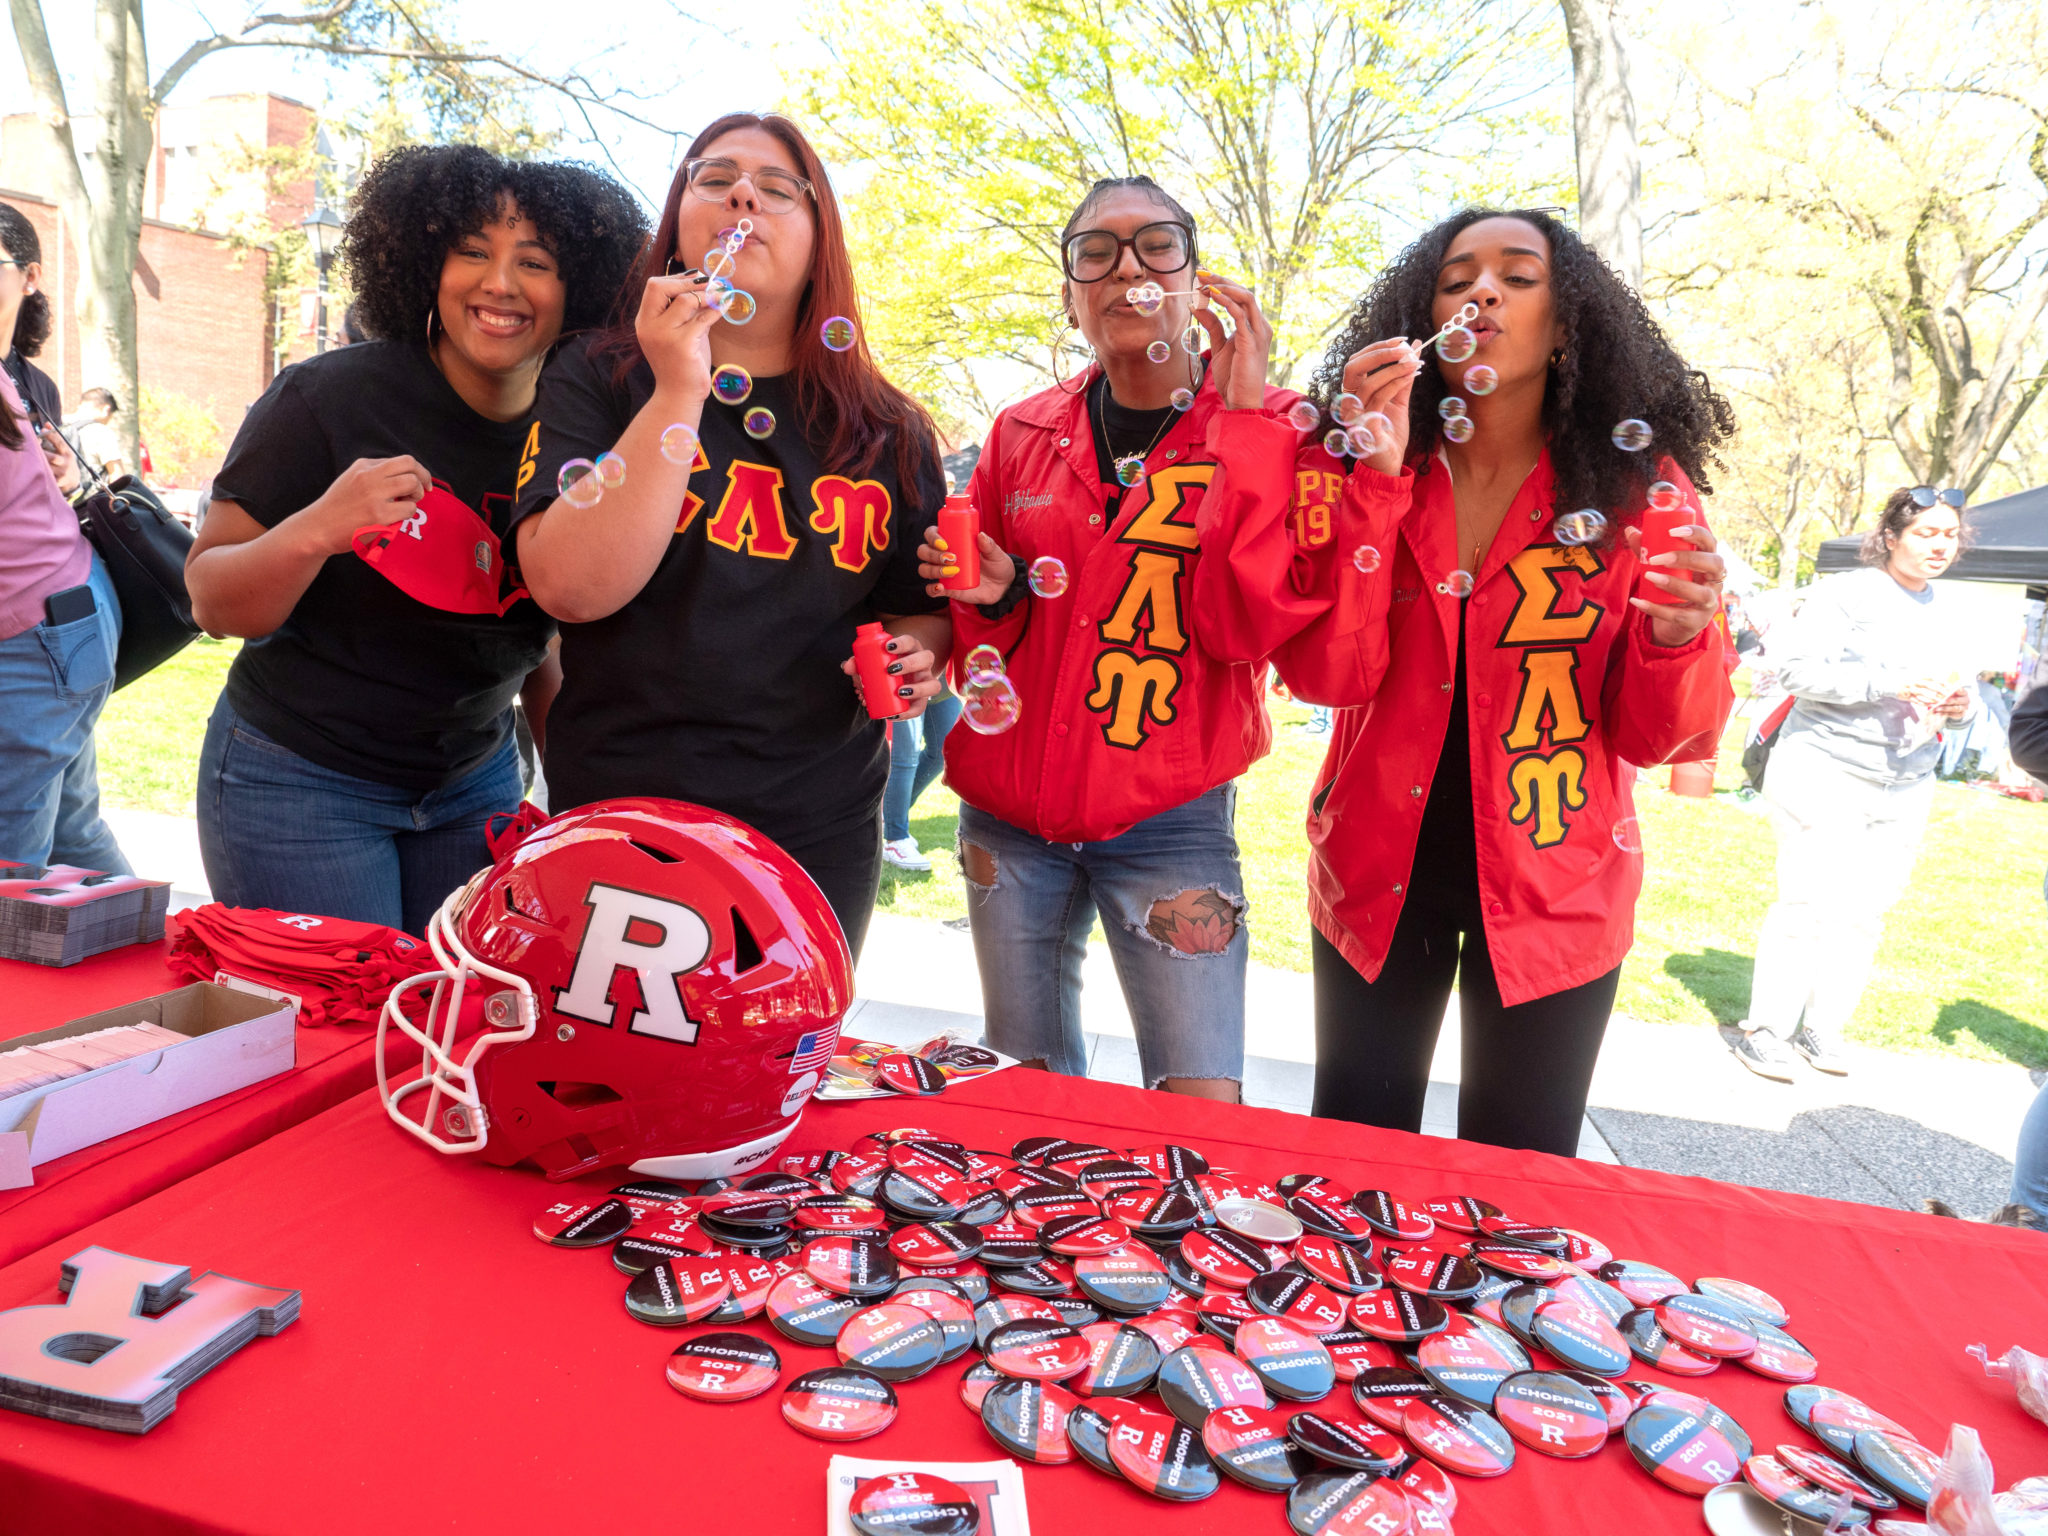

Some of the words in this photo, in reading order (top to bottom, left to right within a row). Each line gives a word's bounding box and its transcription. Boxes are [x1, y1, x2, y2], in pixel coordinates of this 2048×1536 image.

[400, 507, 428, 541] R
[1294, 503, 1332, 547] 19
[276, 914, 324, 931] R
[552, 880, 712, 1046] R
[912, 1152, 940, 1166] 2021
[913, 1144, 963, 1170] CHOPPED
[1056, 1148, 1109, 1160] CHOPPED
[1075, 1157, 1103, 1166] 2021
[916, 1174, 944, 1191] 2021
[934, 1171, 956, 1184] R
[1092, 1171, 1150, 1179] CHOPPED
[891, 1172, 938, 1206] CHOPPED
[1026, 1194, 1085, 1204] CHOPPED
[1043, 1204, 1077, 1212] 2021
[546, 1202, 573, 1215] R
[563, 1205, 591, 1223] 2021
[566, 1204, 614, 1238] CHOPPED
[669, 1219, 693, 1233] R
[1053, 1216, 1101, 1238] CHOPPED
[651, 1232, 684, 1243] 2021
[918, 1232, 940, 1247] 2021
[930, 1223, 967, 1250] CHOPPED
[1076, 1225, 1104, 1238] 2021
[1093, 1232, 1119, 1245] R
[622, 1240, 684, 1258] CHOPPED
[897, 1239, 921, 1252] R
[1210, 1233, 1265, 1272] CHOPPED
[809, 1249, 829, 1263] R
[838, 1249, 847, 1270] 2021
[1198, 1253, 1222, 1271] R
[1208, 1245, 1239, 1266] 2021
[1396, 1259, 1418, 1270] R
[748, 1265, 772, 1283] R
[858, 1246, 868, 1286] CHOPPED
[1420, 1260, 1435, 1277] 2021
[1437, 1259, 1457, 1290] CHOPPED
[679, 1271, 695, 1296] 2021
[700, 1268, 723, 1286] R
[729, 1268, 747, 1292] 2021
[789, 1274, 817, 1289] R
[1089, 1276, 1156, 1284] CHOPPED
[654, 1266, 675, 1309] CHOPPED
[796, 1289, 832, 1304] 2021
[1273, 1276, 1304, 1308] CHOPPED
[910, 1292, 933, 1307] R
[1296, 1293, 1317, 1312] 2021
[789, 1300, 855, 1326] CHOPPED
[858, 1308, 888, 1326] R
[1315, 1305, 1340, 1323] R
[1356, 1304, 1376, 1315] R
[1382, 1300, 1396, 1319] 2021
[1402, 1294, 1420, 1331] CHOPPED
[1677, 1302, 1749, 1331] CHOPPED
[867, 1321, 904, 1342] 2021
[1256, 1319, 1284, 1336] R
[1687, 1316, 1726, 1333] 2021
[1000, 1327, 1071, 1345] CHOPPED
[1266, 1340, 1299, 1350] 2021
[1689, 1327, 1713, 1346] R
[693, 1346, 771, 1362] CHOPPED
[861, 1329, 928, 1365] CHOPPED
[1022, 1342, 1061, 1355] 2021
[1089, 1340, 1108, 1367] 2021
[1333, 1345, 1369, 1355] 2021
[700, 1360, 743, 1372] 2021
[1036, 1354, 1067, 1371] R
[1104, 1334, 1133, 1387] CHOPPED
[1260, 1357, 1321, 1371] CHOPPED
[698, 1373, 726, 1390] R
[808, 1381, 888, 1398] CHOPPED
[817, 1396, 860, 1409] 2021
[1516, 1387, 1597, 1412] CHOPPED
[1019, 1381, 1032, 1437] CHOPPED
[1043, 1401, 1055, 1431] 2021
[1222, 1408, 1254, 1426] R
[1532, 1406, 1575, 1424] 2021
[818, 1411, 846, 1430] R
[1358, 1422, 1387, 1437] R
[1437, 1403, 1505, 1455] CHOPPED
[1117, 1424, 1144, 1445] R
[1236, 1427, 1272, 1443] 2021
[1302, 1414, 1363, 1452] CHOPPED
[1335, 1421, 1372, 1443] 2021
[1435, 1419, 1474, 1448] 2021
[1540, 1423, 1567, 1446] R
[1651, 1416, 1697, 1453] CHOPPED
[1148, 1432, 1165, 1461] 2021
[1423, 1430, 1452, 1454] R
[1168, 1433, 1191, 1486] CHOPPED
[1232, 1442, 1298, 1465] CHOPPED
[1679, 1440, 1708, 1464] 2021
[1701, 1460, 1733, 1484] R
[887, 1474, 919, 1490] R
[888, 1493, 935, 1505] 2021
[1310, 1472, 1368, 1519] CHOPPED
[869, 1508, 959, 1525] CHOPPED
[1341, 1494, 1376, 1524] 2021
[1365, 1512, 1399, 1536] R
[1416, 1508, 1446, 1530] R
